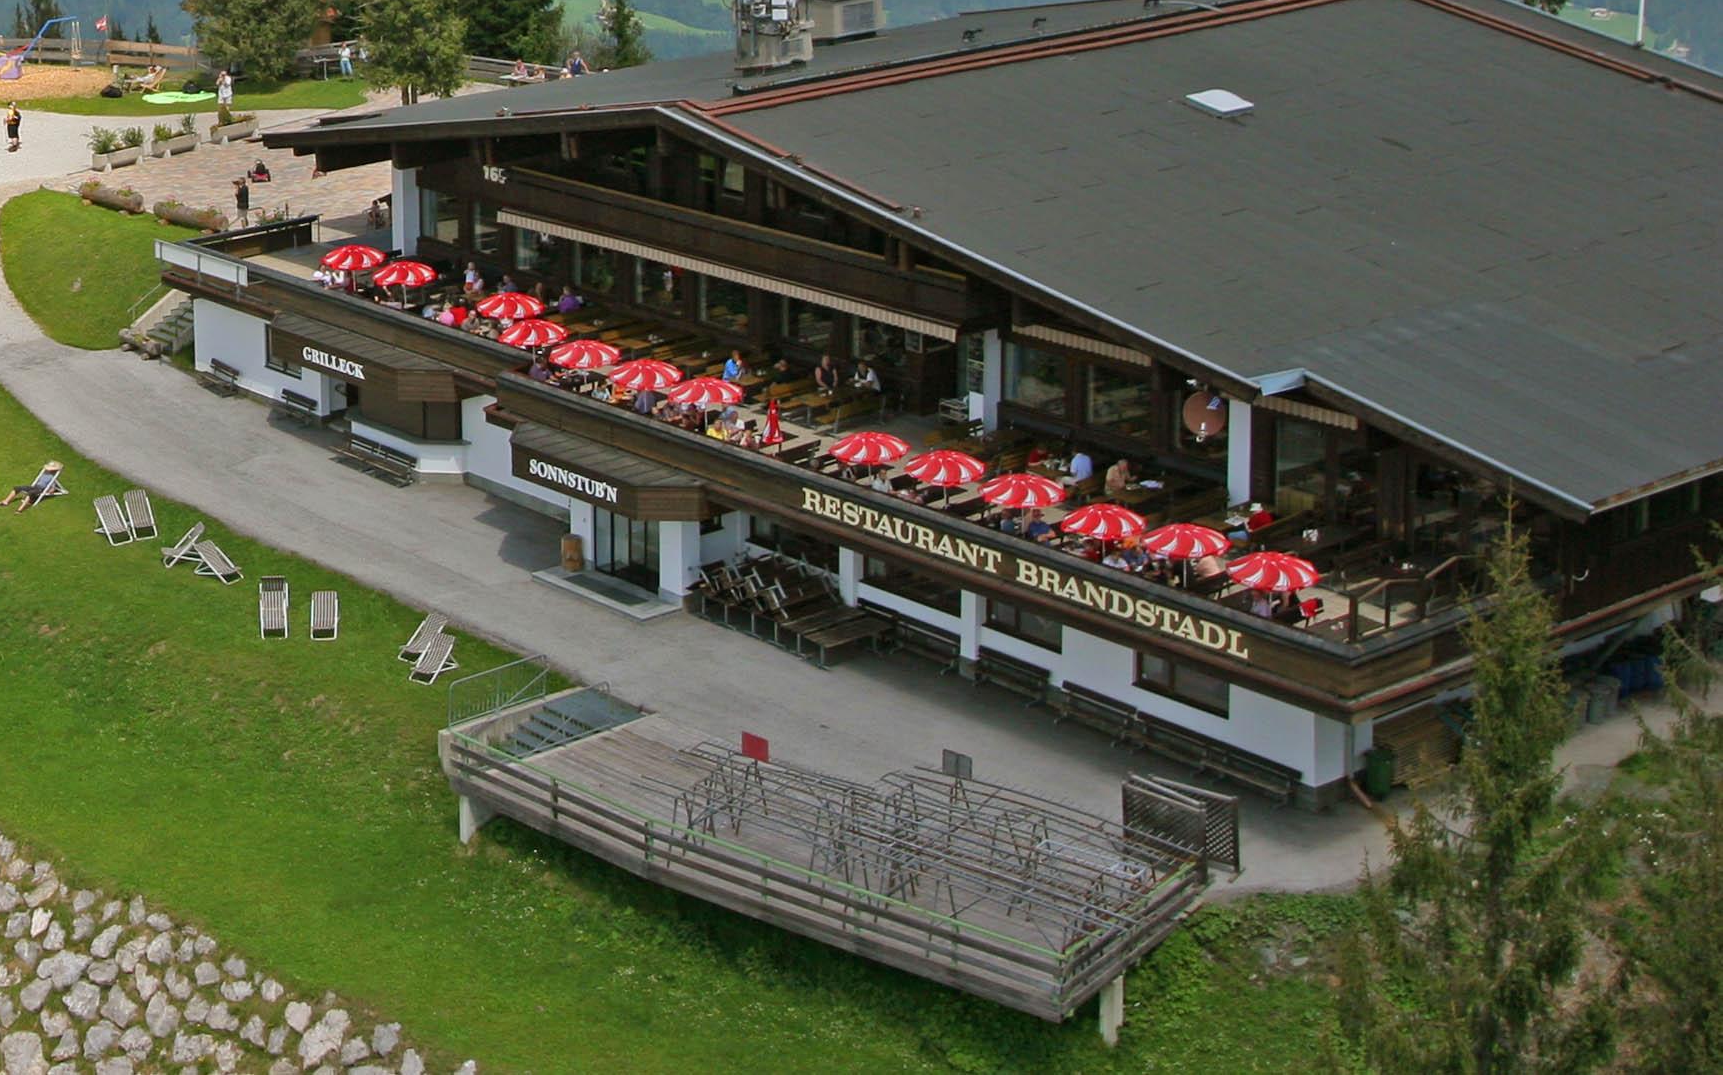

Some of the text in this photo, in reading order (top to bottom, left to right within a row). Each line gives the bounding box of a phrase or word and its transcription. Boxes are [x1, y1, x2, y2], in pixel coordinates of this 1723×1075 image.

[302, 346, 366, 380] GRILLECK
[529, 458, 618, 503] SONNSTUB'N
[801, 486, 1249, 659] RESTAURANT BRANDSTADL
